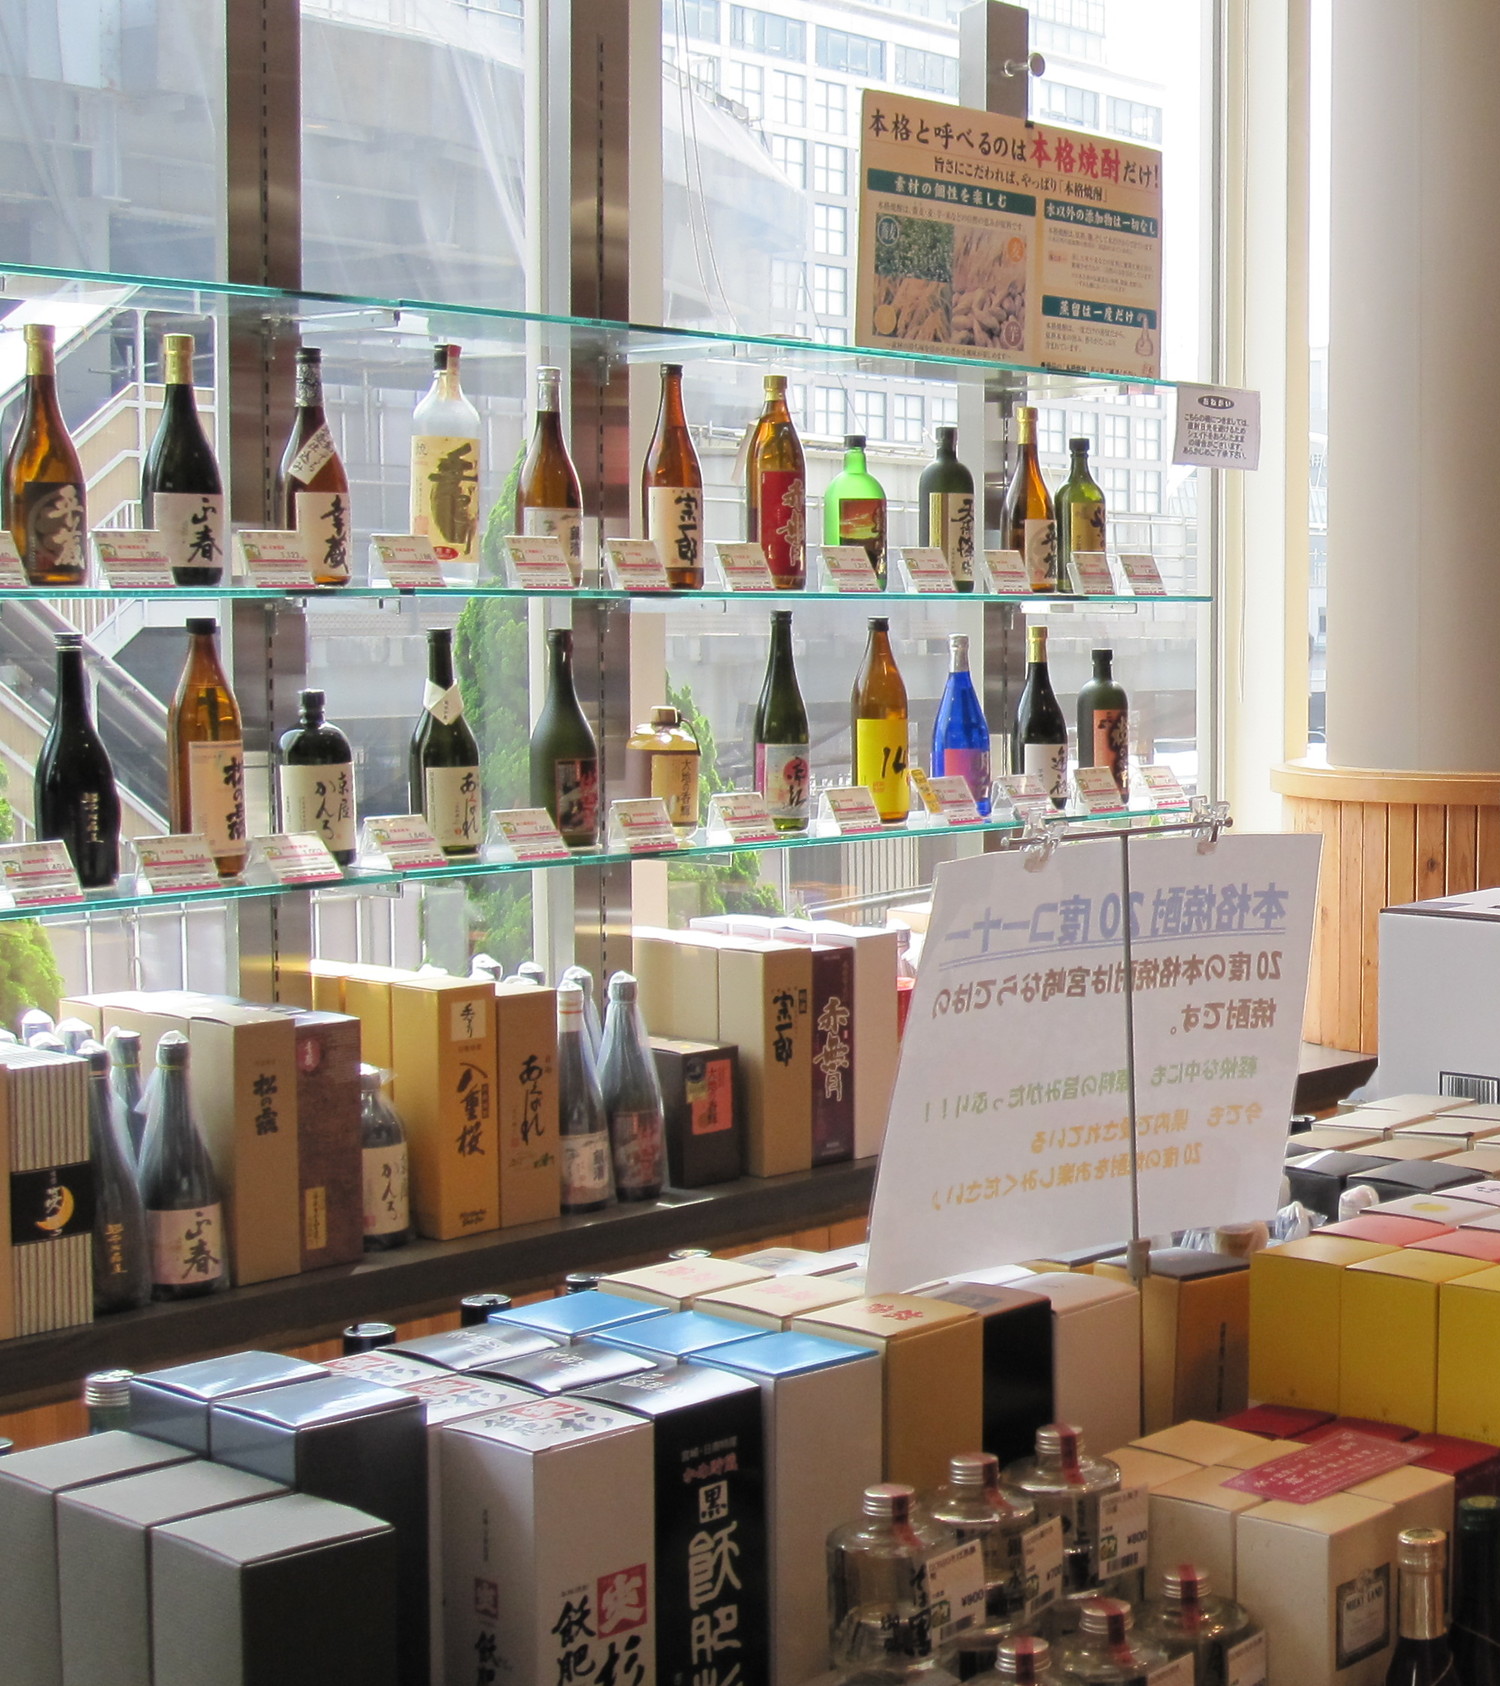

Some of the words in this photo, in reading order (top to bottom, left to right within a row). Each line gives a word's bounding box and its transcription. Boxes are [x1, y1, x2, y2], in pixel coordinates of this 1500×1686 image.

[894, 176, 1008, 209] 素材の個性を楽しむ
[1046, 203, 1156, 235] 水以外の添加物は一切なし
[1059, 300, 1134, 322] 蒸留は一度だけ
[253, 1073, 278, 1135] 松の露
[688, 1481, 743, 1686] 黒飫肥
